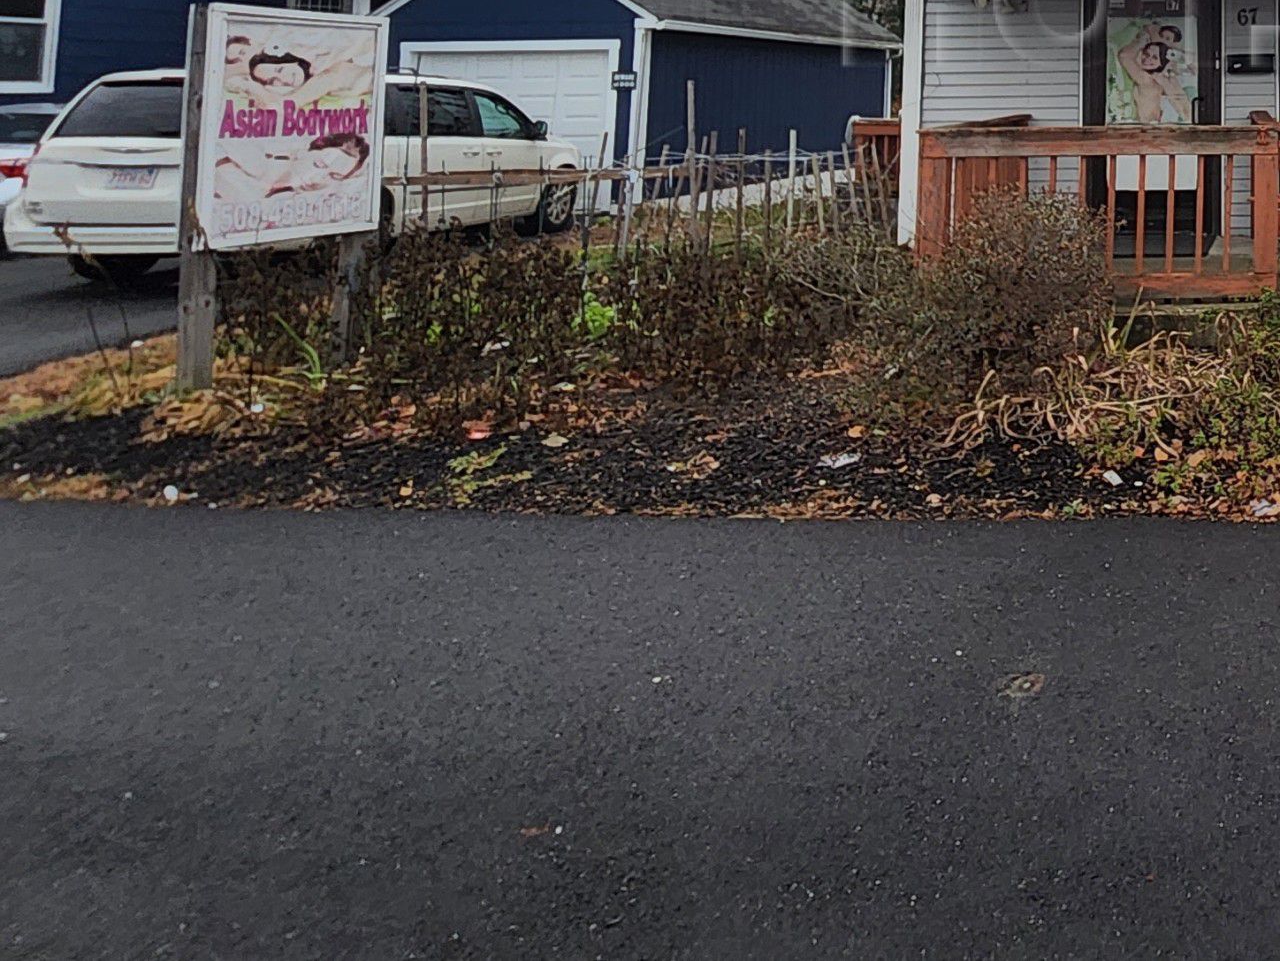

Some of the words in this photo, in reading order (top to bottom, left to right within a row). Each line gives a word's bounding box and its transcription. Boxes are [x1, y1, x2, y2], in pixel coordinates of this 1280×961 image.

[1236, 8, 1259, 27] 67
[218, 99, 278, 138] Asian
[282, 99, 369, 144] Bodywork
